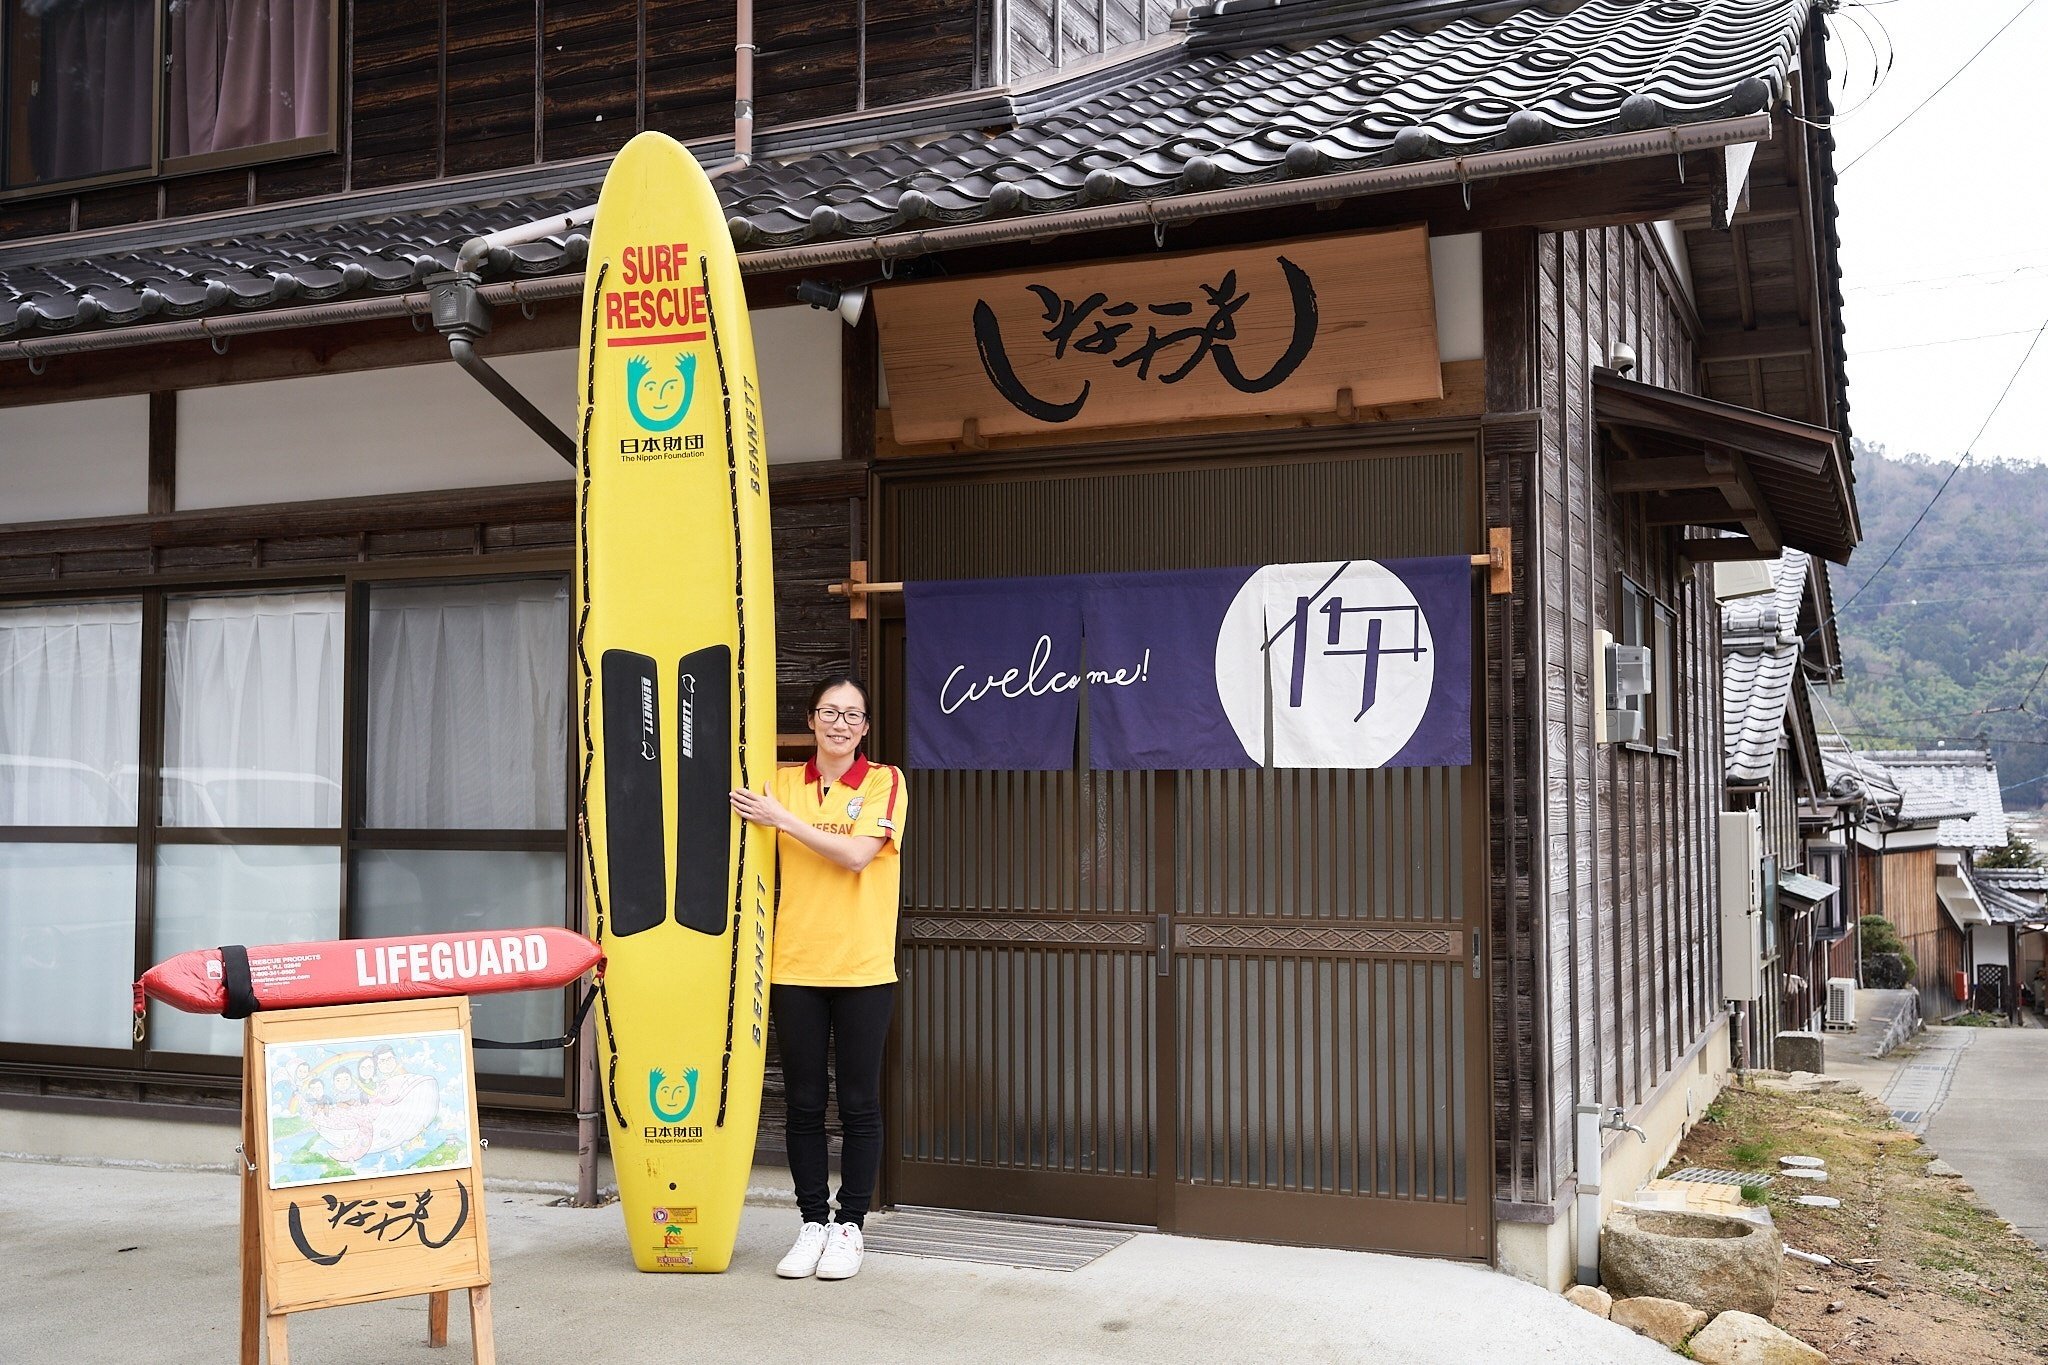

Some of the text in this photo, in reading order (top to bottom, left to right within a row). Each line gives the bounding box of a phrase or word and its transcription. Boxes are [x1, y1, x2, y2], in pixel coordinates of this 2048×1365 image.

[622, 243, 688, 285] SURF
[606, 286, 707, 329] RESCUE
[620, 435, 704, 454] 日本財団
[637, 452, 662, 462] Nippon
[664, 450, 705, 460] Foundation
[743, 375, 760, 496] BENNETT
[940, 634, 1150, 714] welcome!
[642, 676, 654, 735] BENNETT
[682, 699, 692, 758] BENNETT
[252, 954, 321, 966] RESCUE PRODUCTS
[355, 934, 549, 987] LIFEGUARD
[752, 874, 766, 1049] BENNETT
[644, 1126, 703, 1138] 日本財団
